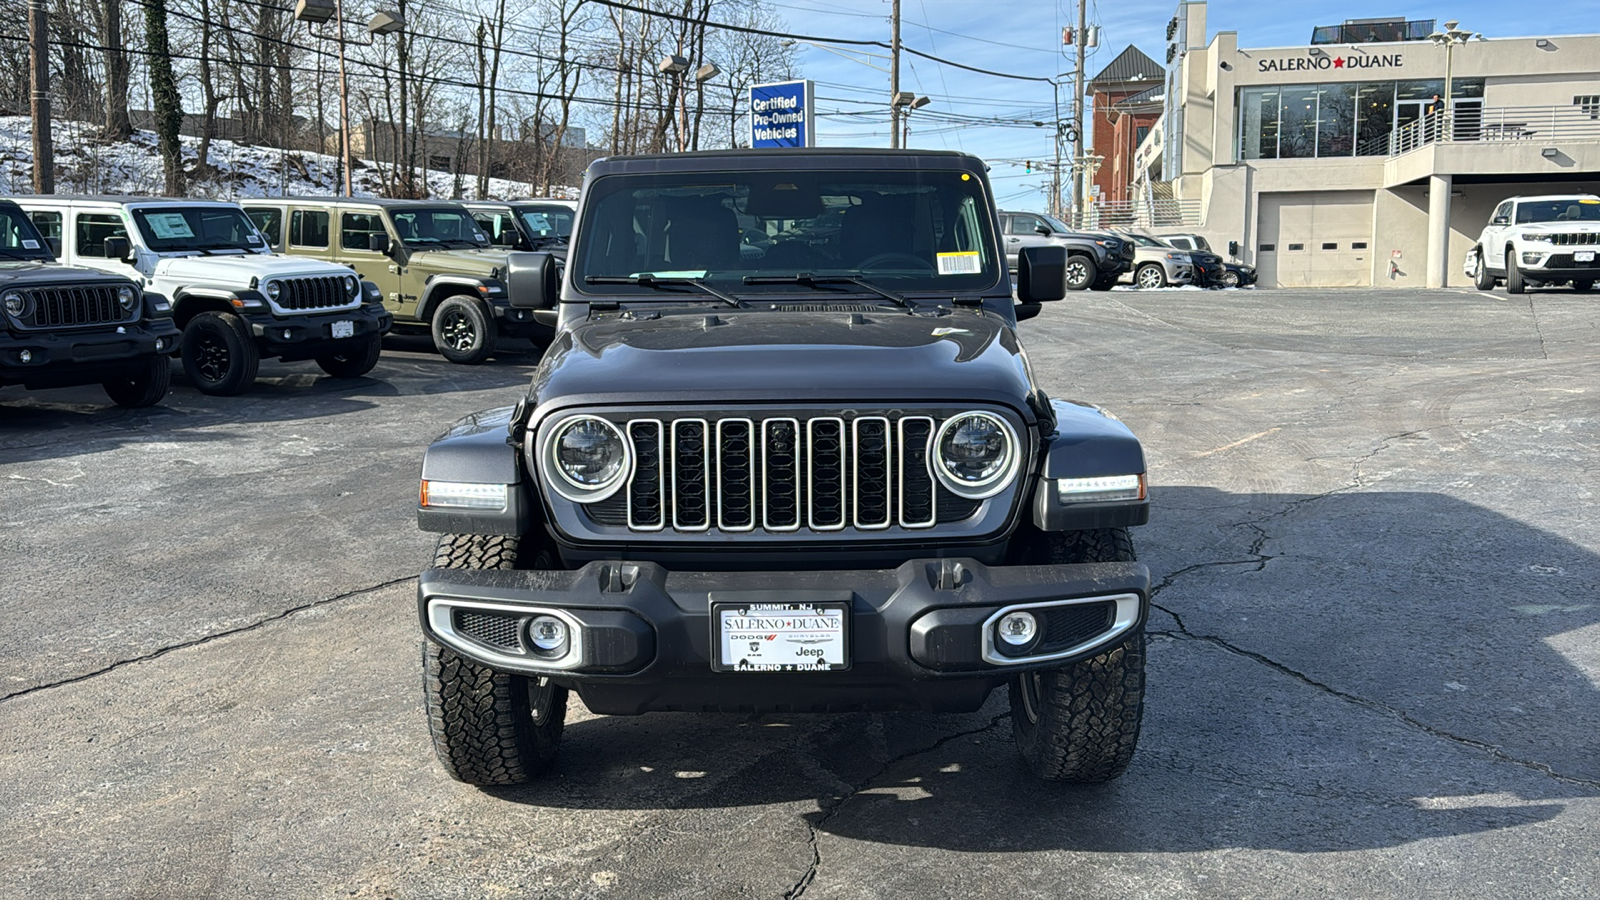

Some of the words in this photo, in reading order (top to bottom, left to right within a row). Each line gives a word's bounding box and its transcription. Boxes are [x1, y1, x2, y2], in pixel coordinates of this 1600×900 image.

[1258, 57, 1331, 72] SALERNO
[1347, 54, 1403, 68] DUANE
[753, 95, 797, 111] Certified
[753, 110, 803, 126] Pre-Owned
[754, 127, 797, 141] Vehicles
[799, 603, 813, 611] NJ
[724, 618, 785, 630] SALERNO
[792, 617, 840, 630] DUANE
[795, 646, 824, 658] Jeep
[733, 664, 782, 672] SALERNO
[796, 663, 831, 671] DUANE
